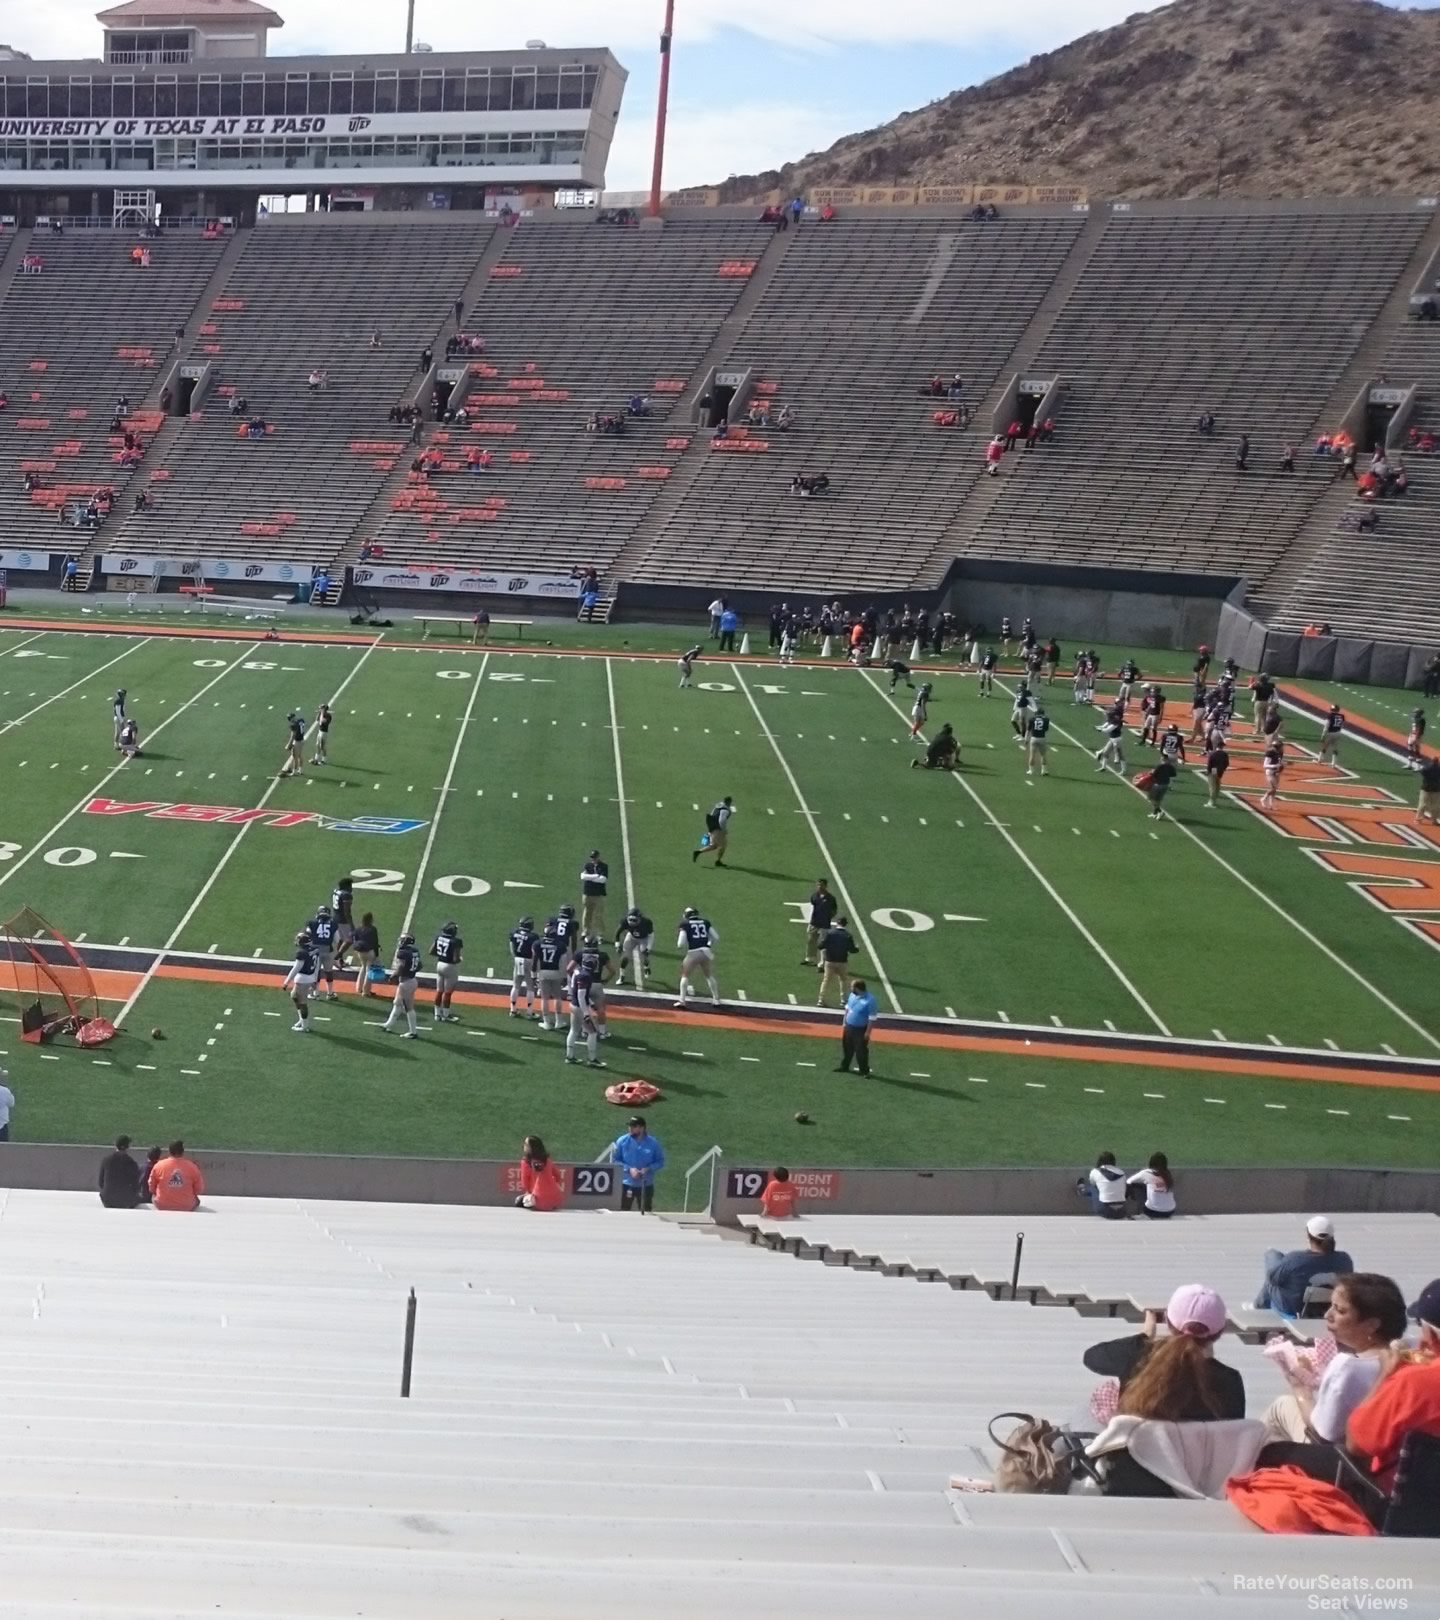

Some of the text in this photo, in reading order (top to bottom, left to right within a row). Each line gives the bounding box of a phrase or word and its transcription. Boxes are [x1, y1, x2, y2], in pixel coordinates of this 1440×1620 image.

[113, 120, 138, 135] OF
[143, 119, 206, 135] TEXAS
[211, 119, 240, 134] AT
[243, 119, 265, 134] EL
[270, 117, 326, 133] PASO
[350, 868, 492, 897] 20
[316, 924, 331, 939] 45
[557, 922, 567, 936] 6
[690, 924, 708, 939] 33
[436, 941, 450, 957] 57
[542, 949, 555, 963] 17
[577, 1170, 610, 1193] 20
[734, 1173, 762, 1196] 19
